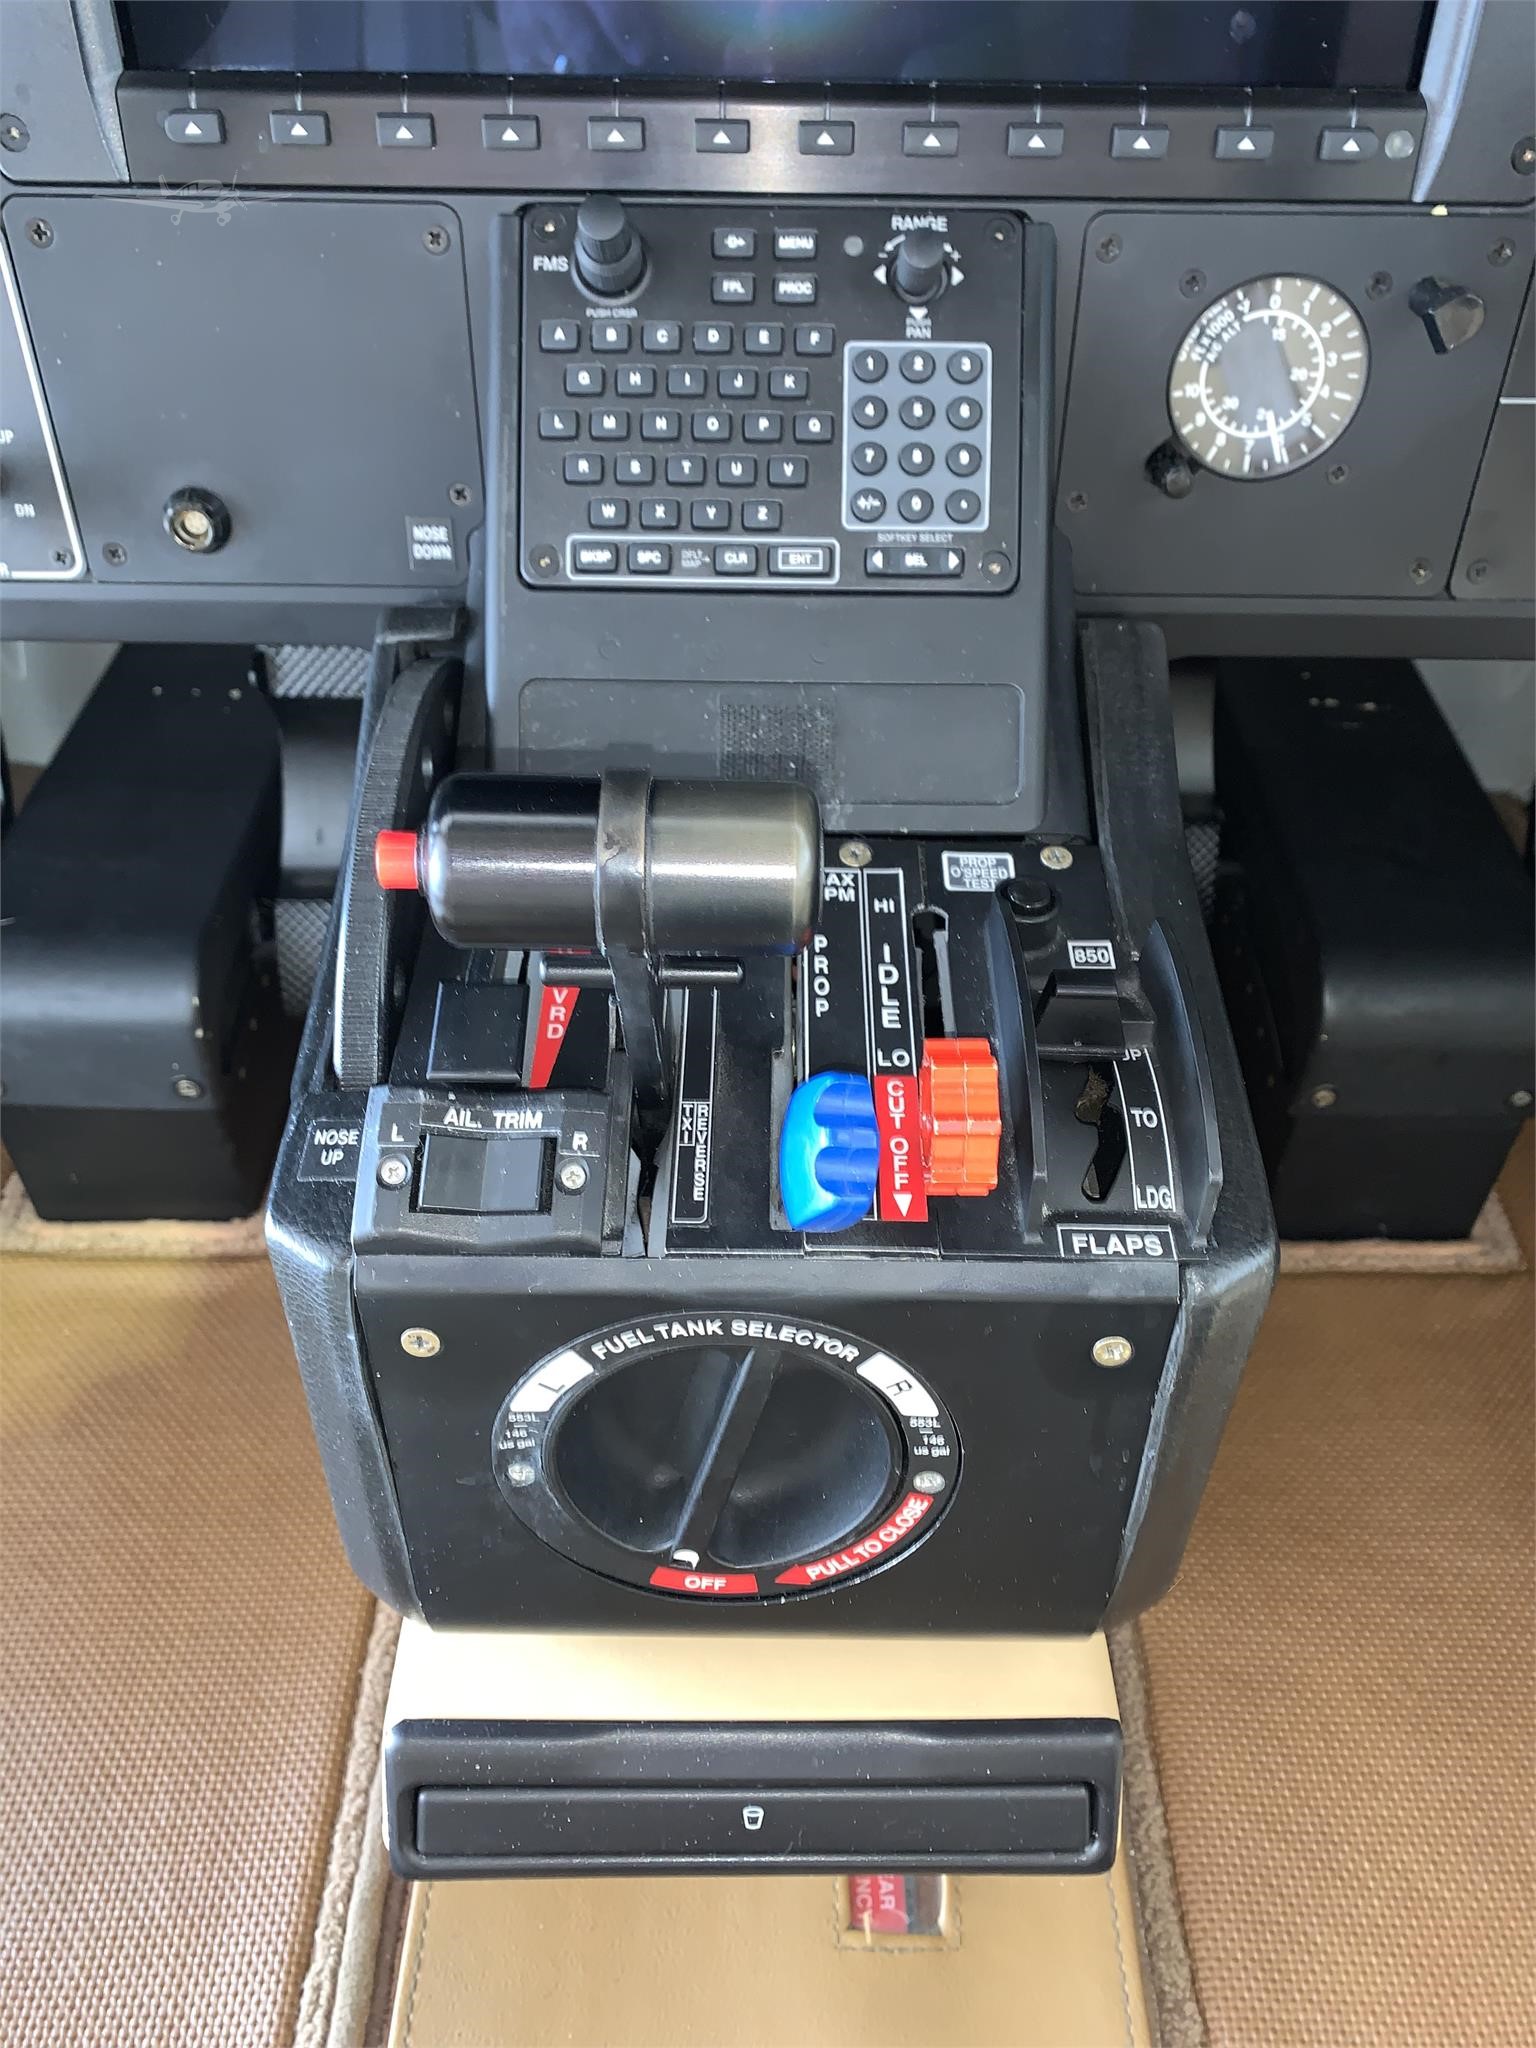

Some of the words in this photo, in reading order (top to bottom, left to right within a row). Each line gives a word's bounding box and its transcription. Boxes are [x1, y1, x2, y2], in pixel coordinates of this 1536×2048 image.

[892, 215, 949, 232] RANGE
[778, 236, 814, 250] MENU
[533, 255, 569, 272] FMS
[722, 279, 745, 294] FPL
[778, 281, 813, 295] PROC
[1207, 307, 1236, 339] 1000
[1320, 322, 1332, 338] 2
[554, 326, 566, 341] A
[605, 327, 618, 342] B
[656, 328, 669, 344] C
[707, 328, 720, 344] D
[758, 329, 770, 345] E
[810, 331, 820, 346] F
[906, 328, 932, 339] PAN
[866, 355, 874, 371] 1
[913, 356, 924, 371] 2
[1327, 353, 1338, 367] 3
[629, 371, 642, 386] H
[684, 372, 691, 387] I
[733, 373, 743, 388] J
[784, 374, 796, 389] K
[1185, 384, 1199, 398] 10
[1319, 384, 1330, 398] 4
[553, 414, 564, 430] L
[602, 414, 616, 429] M
[655, 416, 667, 431] N
[706, 417, 719, 432] O
[758, 417, 770, 432] P
[808, 418, 821, 433] Q
[578, 459, 590, 473] R
[681, 460, 692, 475] T
[731, 461, 743, 477] U
[783, 462, 794, 477] V
[14, 503, 36, 518] DN
[601, 503, 616, 519] W
[911, 495, 922, 512] 0
[655, 504, 666, 519] X
[706, 506, 717, 520] Y
[757, 505, 768, 521] Z
[412, 525, 448, 542] NOSE
[877, 533, 916, 543] SOFTKEY
[919, 533, 953, 543] SELECT
[412, 543, 452, 560] DOWN
[636, 550, 662, 565] SPC
[724, 551, 748, 565] CLR
[789, 552, 812, 567] ENT
[904, 553, 928, 567] SEL
[959, 857, 998, 868] PROP
[826, 873, 856, 887] AX
[950, 867, 1009, 881] O'SPEED
[963, 878, 996, 890] TEST
[824, 887, 856, 902] PM
[873, 898, 895, 914] HI
[1074, 949, 1110, 964] 850
[813, 933, 831, 1018] PROP
[878, 943, 901, 1028] IDLE
[876, 1047, 911, 1068] LO
[886, 1080, 906, 1130] CUT
[444, 1108, 483, 1129] AIL.
[493, 1110, 543, 1130] TRIM
[681, 1104, 694, 1144] TXI
[1130, 1107, 1158, 1129] TO
[313, 1127, 360, 1146] NOSE
[391, 1124, 404, 1142] L
[571, 1131, 589, 1151] R
[320, 1149, 345, 1166] UP
[693, 1104, 709, 1202] REVERSE
[888, 1137, 909, 1190] OFF
[1137, 1185, 1173, 1209] LDG
[1071, 1233, 1164, 1256] FLAPS
[591, 1327, 656, 1360] FUEL
[653, 1318, 724, 1340] TANK
[731, 1319, 860, 1363] SELECTOR
[538, 1382, 565, 1393] L
[931, 1445, 950, 1458] gal
[805, 1548, 860, 1581] PULL
[852, 1536, 884, 1562] TO
[878, 1494, 929, 1543] CLOSE
[683, 1573, 727, 1590] OFF
